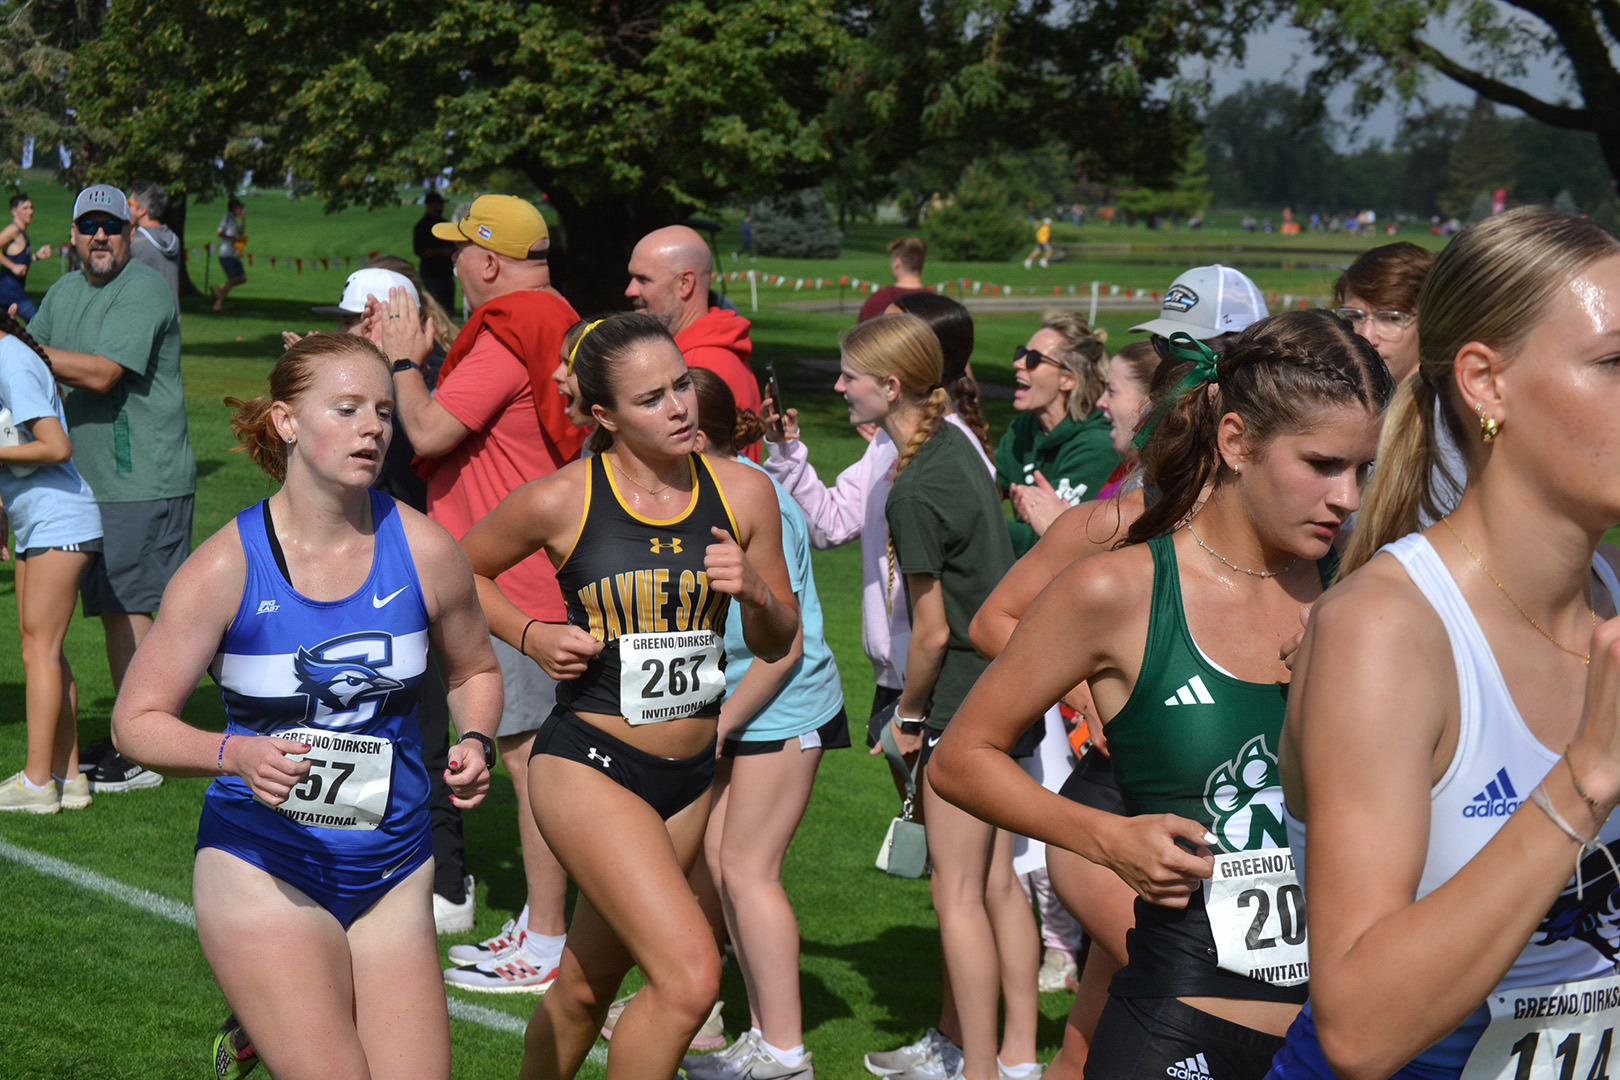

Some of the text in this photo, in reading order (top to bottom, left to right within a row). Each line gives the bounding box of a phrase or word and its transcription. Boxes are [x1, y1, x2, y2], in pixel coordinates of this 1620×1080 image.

[577, 568, 728, 642] WAYNE STA
[633, 634, 715, 650] GREENO/DIRKSEN
[641, 654, 707, 699] 267
[295, 757, 356, 805] 57
[275, 807, 358, 826] INVITATIONAL
[1237, 884, 1307, 951] 20
[1514, 986, 1620, 1019] GREENO/DIRKS
[1510, 1027, 1615, 1080] 114
